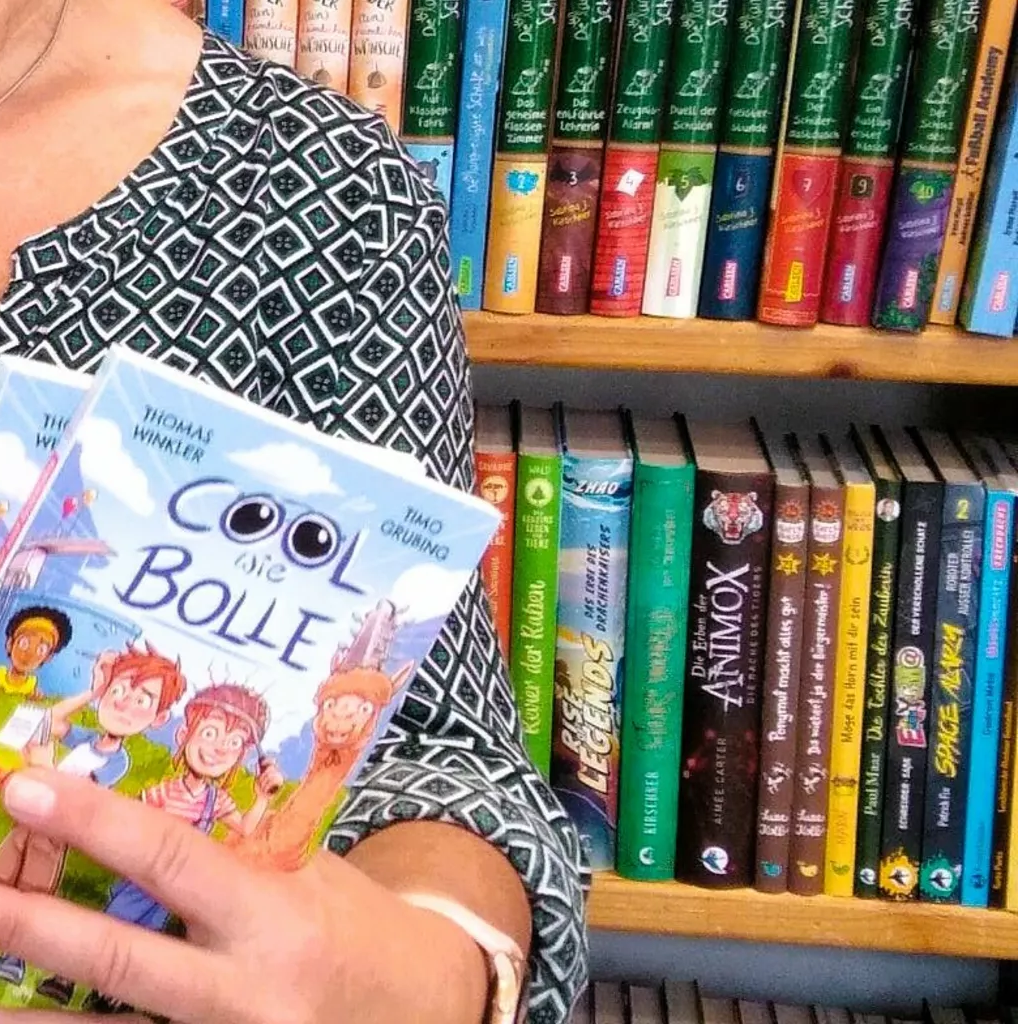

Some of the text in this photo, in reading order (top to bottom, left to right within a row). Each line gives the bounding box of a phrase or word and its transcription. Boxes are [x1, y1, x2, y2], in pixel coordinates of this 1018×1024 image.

[976, 46, 1002, 111] Academy
[568, 171, 579, 186] 3
[680, 175, 690, 187] 5
[735, 177, 745, 192] 6
[858, 180, 868, 194] 9
[132, 425, 206, 465] WINKLER
[142, 404, 215, 444] THOMAS
[576, 479, 619, 495] ZHAO
[167, 476, 368, 596] COOL
[380, 519, 451, 562] GRUBING
[403, 507, 445, 534] TIMO
[234, 551, 288, 584] wie
[584, 544, 596, 619] DAS ERBE DES
[595, 524, 611, 632] DRACHENKAISERS
[913, 521, 927, 618] VERSCHOLLENE SCHATZ
[945, 553, 959, 592] ROBOTER
[958, 582, 972, 615] AUSSER
[112, 543, 336, 673] BOLLE
[691, 594, 707, 678] Die Erben der
[700, 560, 751, 712] ANIMOX
[768, 596, 796, 742] Ponymut macht alles gut
[841, 597, 861, 743] Möge Horn mit dir sein
[561, 686, 582, 754] RISE
[577, 631, 613, 794] LEGENDS
[934, 703, 959, 778] SPACE
[713, 737, 727, 824] AIMÉE CARTER
[865, 752, 881, 815] Paul Maar
